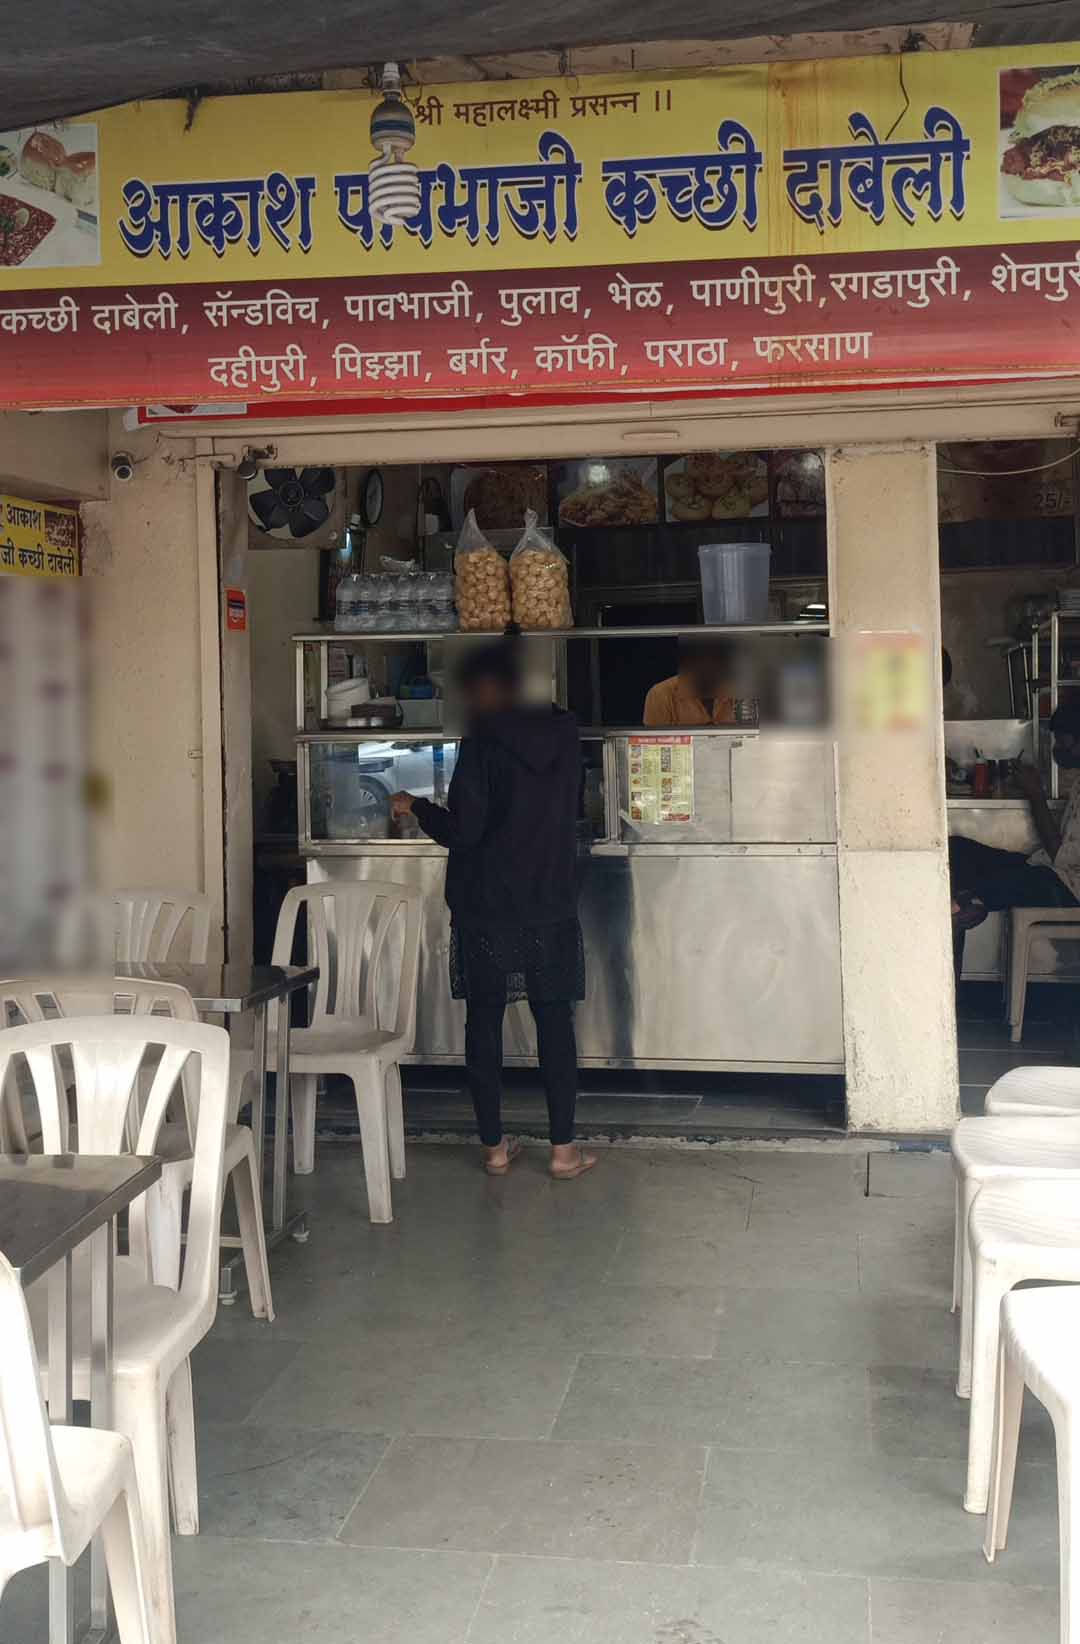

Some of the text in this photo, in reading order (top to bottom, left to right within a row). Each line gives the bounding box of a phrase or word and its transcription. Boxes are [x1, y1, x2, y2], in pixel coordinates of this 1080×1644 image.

[415, 96, 443, 126] श्री
[453, 89, 559, 127] महालक्ष्मी
[570, 91, 640, 118] प्रसन्न
[119, 172, 317, 258] आकाश
[601, 119, 763, 236] कच्छी
[782, 105, 971, 234] दाबेली
[0, 295, 80, 334] कच्छी
[91, 292, 189, 335] दाबेली,
[203, 288, 330, 329] सॅन्डविच,
[344, 279, 484, 324] पावभाजी,
[498, 286, 592, 327] पुलाव,
[607, 272, 674, 316] भेळ,
[690, 264, 826, 315] पाणीपुरी,
[829, 255, 972, 309] रगडापुरी,
[207, 331, 873, 393] दहीपुरी, पिझ्झा, बर्गर, कॉफी, पराठा, फरसाण
[6, 503, 42, 531] आकाश
[18, 543, 44, 571] कच्छी
